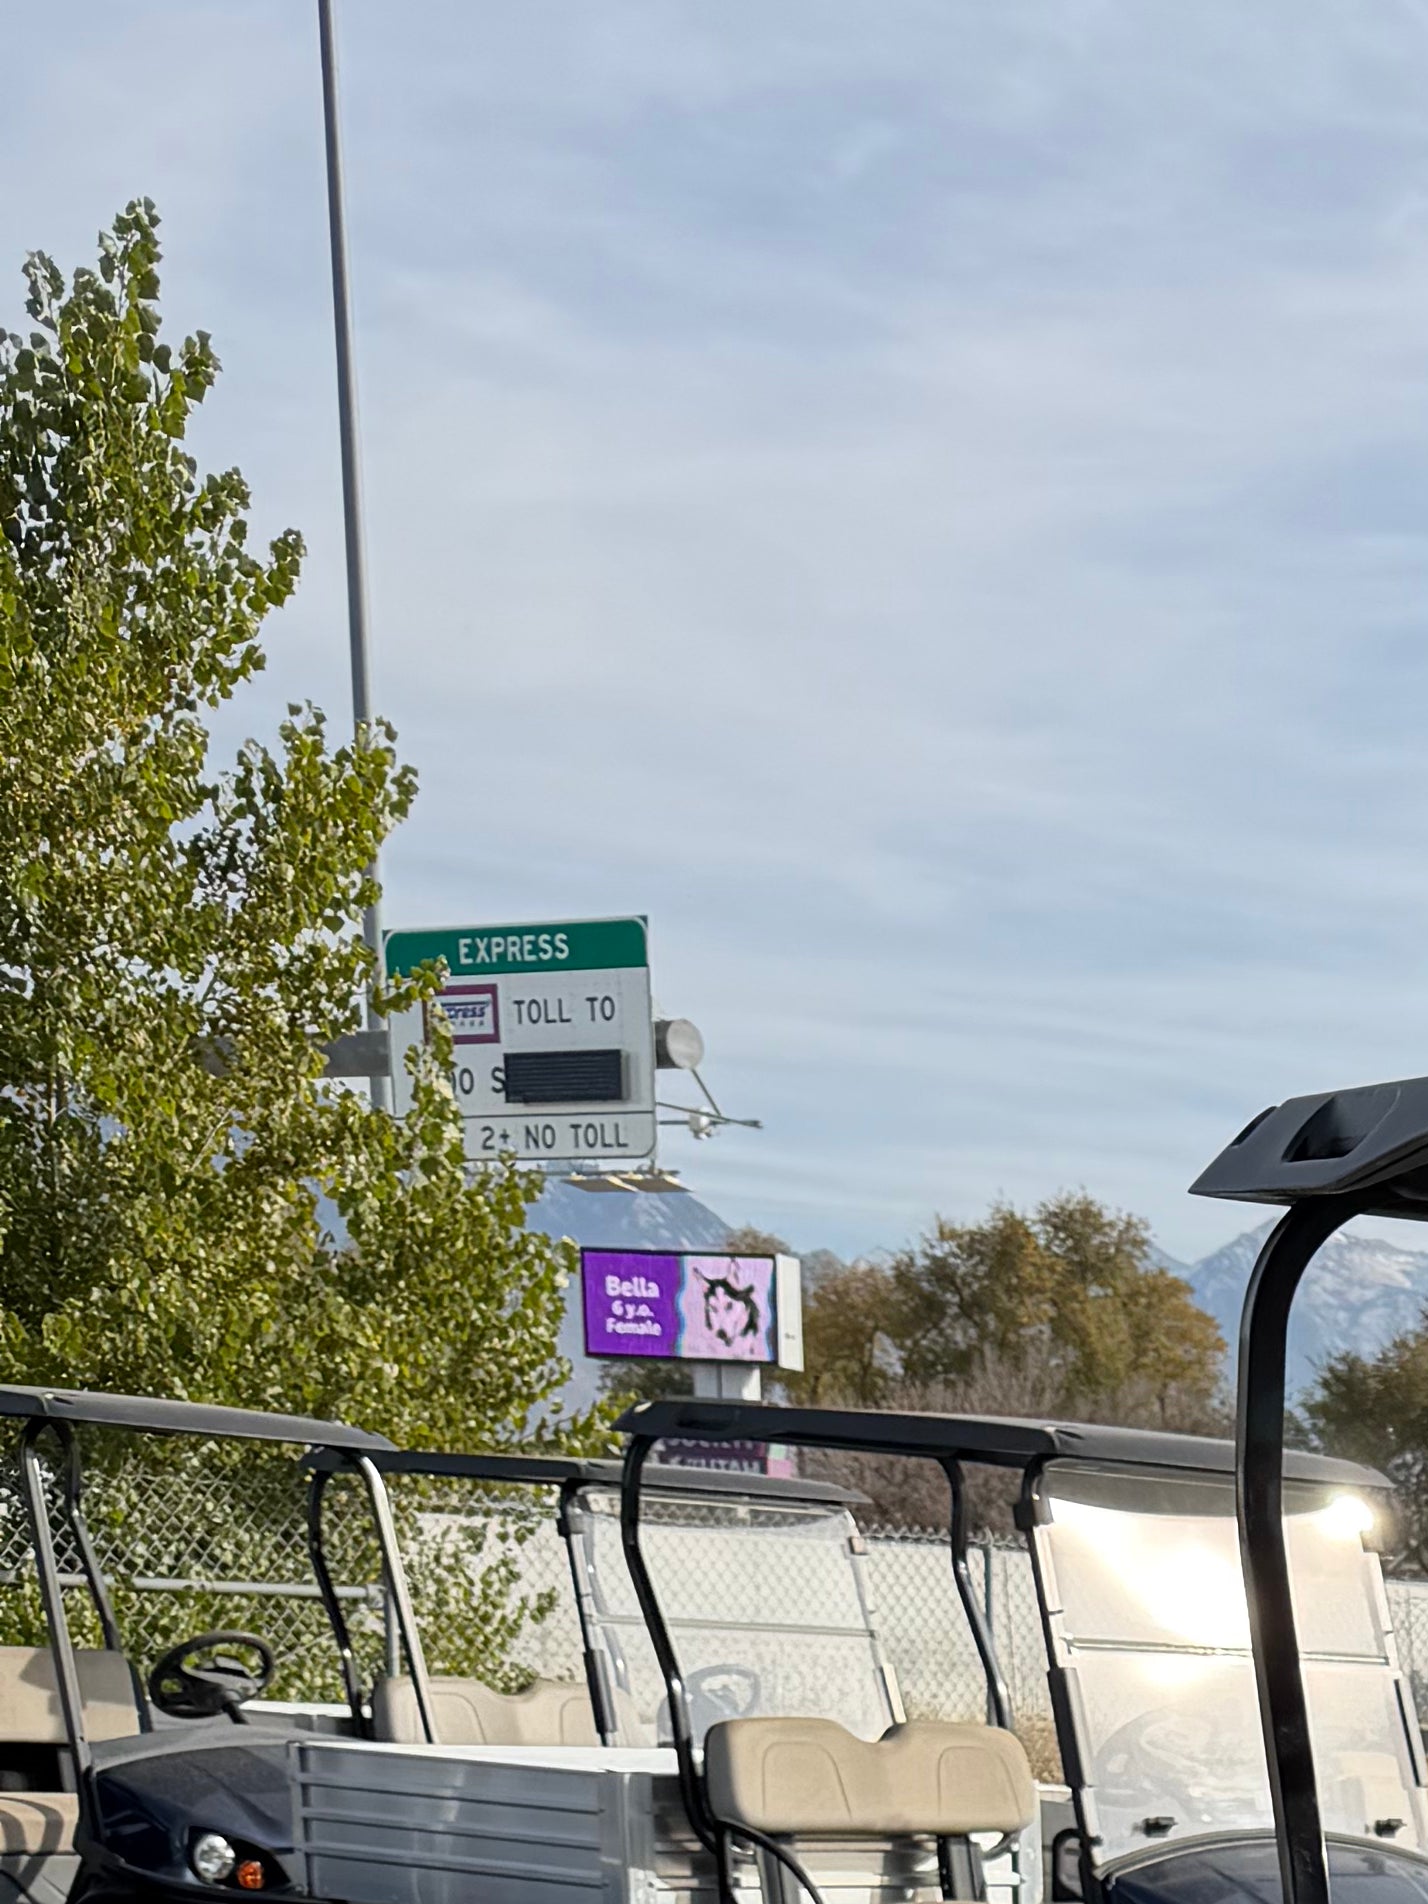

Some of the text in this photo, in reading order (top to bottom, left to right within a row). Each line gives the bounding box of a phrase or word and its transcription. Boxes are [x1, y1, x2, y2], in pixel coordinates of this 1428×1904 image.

[458, 932, 570, 965] EXPRESS
[512, 996, 616, 1025] TOLL TO
[481, 1122, 629, 1150] 2+ NO TOLL
[605, 1274, 660, 1298] Bella
[611, 1300, 624, 1316] 6
[605, 1317, 662, 1337] Female
